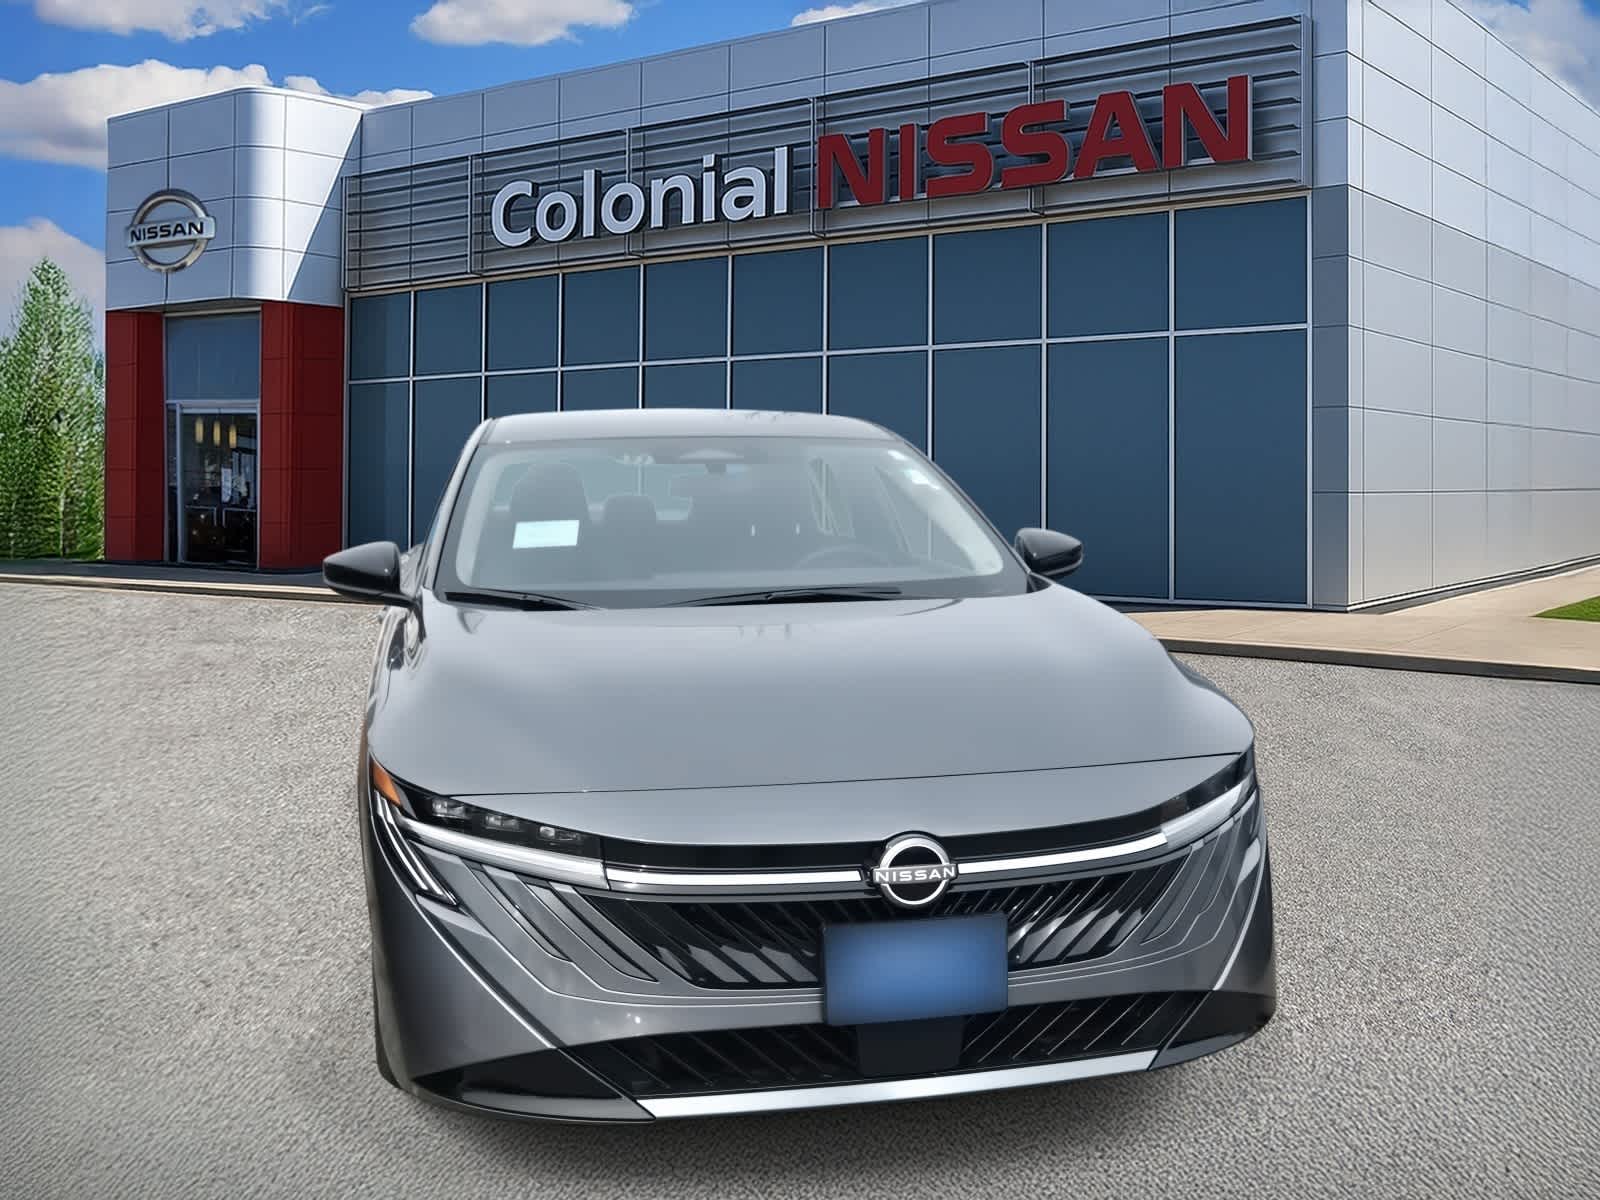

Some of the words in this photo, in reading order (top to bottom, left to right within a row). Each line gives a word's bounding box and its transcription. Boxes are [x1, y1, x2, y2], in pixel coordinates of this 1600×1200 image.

[491, 146, 790, 247] Colonial
[818, 75, 1252, 208] NISSAN
[130, 221, 204, 242] NISSAN
[875, 866, 955, 882] NISSAN
